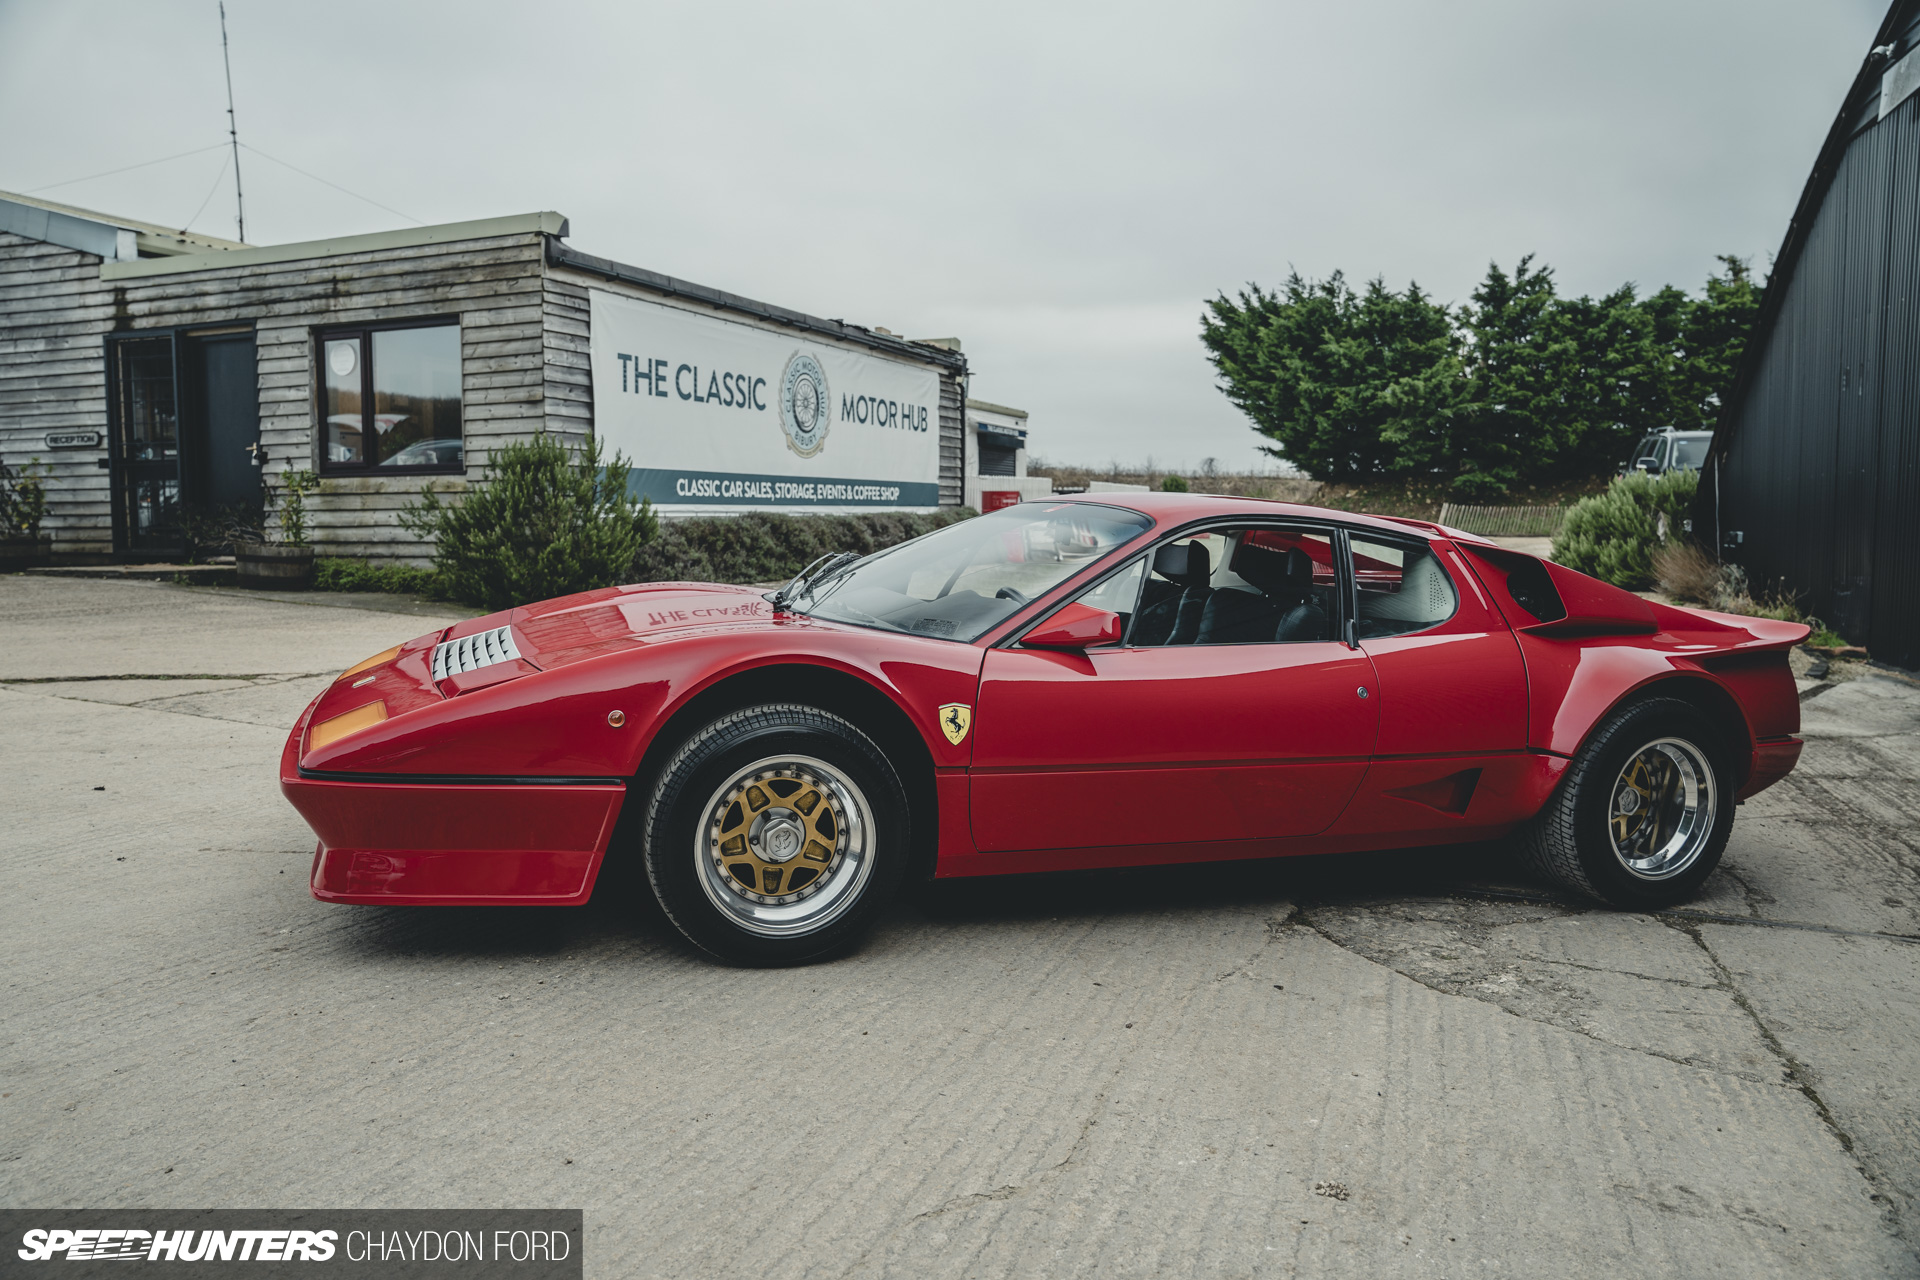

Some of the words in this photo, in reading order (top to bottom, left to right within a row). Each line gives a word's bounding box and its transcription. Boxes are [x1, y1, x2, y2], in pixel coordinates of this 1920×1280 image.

[617, 352, 668, 398] THE
[675, 363, 767, 411] CLASSIC
[841, 391, 897, 429] MOTOR
[901, 402, 928, 433] HUB
[785, 363, 801, 413] CLASSIC
[802, 362, 822, 386] MOTOR
[49, 435, 95, 444] RECEPTION
[794, 430, 817, 447] BIBURY
[676, 478, 721, 497] CLASSIC
[721, 480, 743, 498] CAR
[744, 481, 775, 501] SALES,
[774, 482, 817, 502] STORAGE,
[817, 484, 847, 500] EVENTS
[846, 485, 853, 500] &
[853, 485, 880, 500] COFFEE
[880, 486, 900, 501] SHOP
